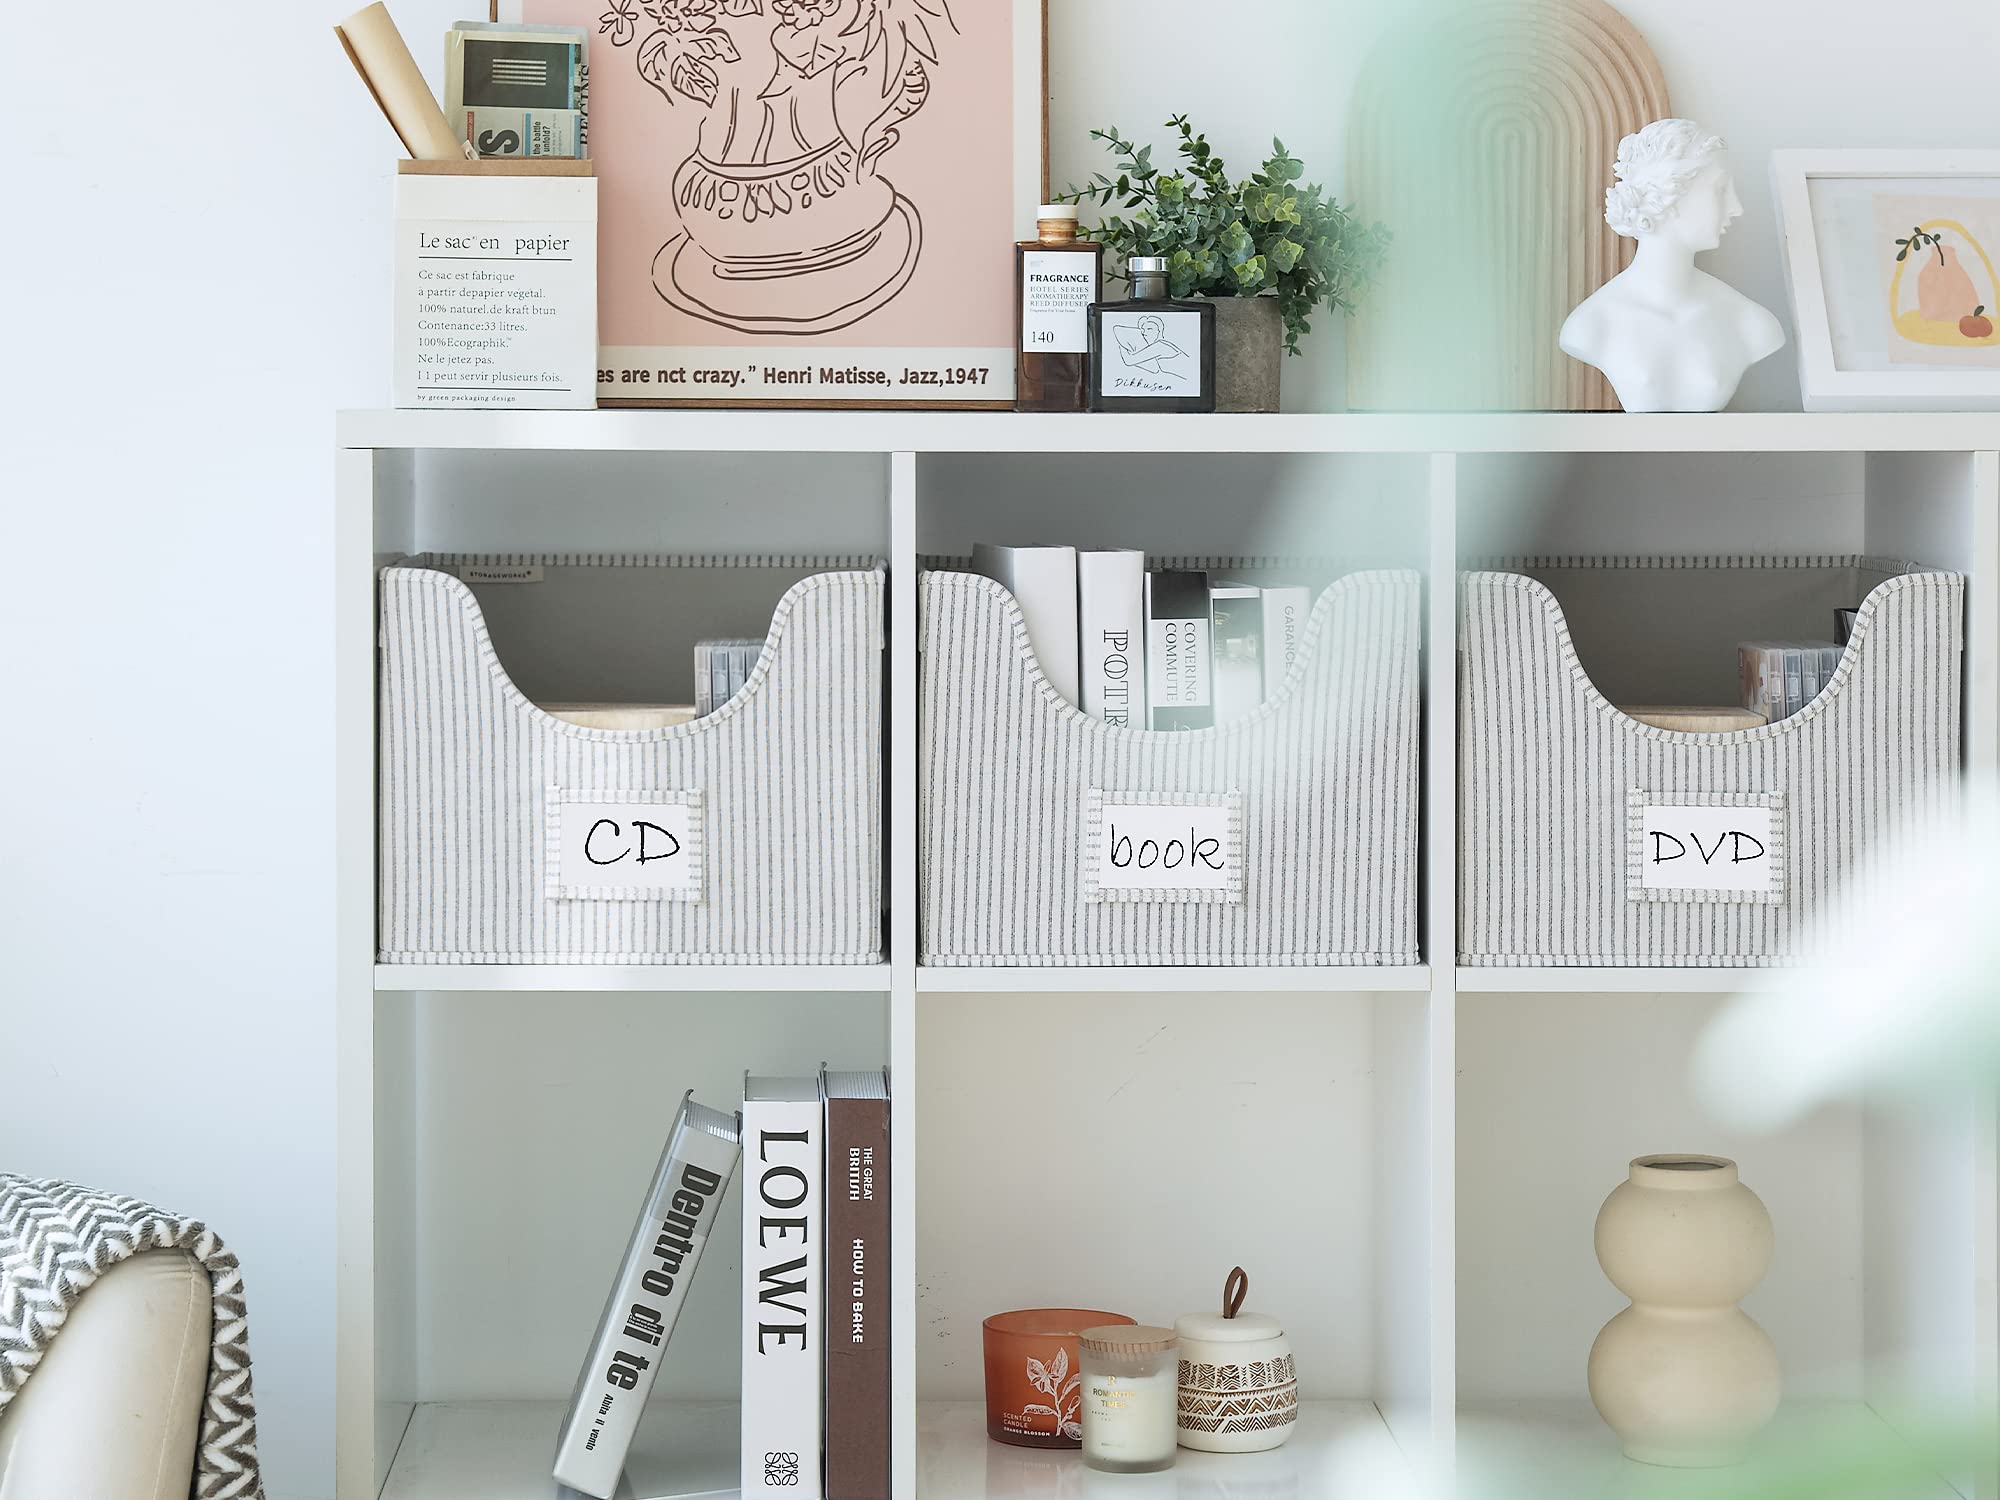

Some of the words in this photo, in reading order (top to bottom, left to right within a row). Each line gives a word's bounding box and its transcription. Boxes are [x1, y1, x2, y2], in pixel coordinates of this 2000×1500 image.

[478, 129, 520, 156] S
[533, 121, 541, 141] battle
[542, 125, 551, 153] unfold?
[533, 142, 541, 155] the
[420, 232, 440, 249] Le
[479, 237, 500, 250] en
[515, 234, 570, 255] papier
[418, 270, 433, 280] Ce
[455, 272, 469, 280] est
[472, 270, 515, 283] fabrique
[1030, 274, 1089, 283] FRAGRANCE
[427, 288, 457, 299] partir
[459, 287, 505, 299] depapier
[419, 303, 447, 314] 100%
[505, 305, 529, 315] kraft
[418, 320, 496, 331] Contenance:33
[499, 321, 528, 331] litres.
[1032, 330, 1054, 344] 140
[418, 354, 433, 364] Ne
[436, 354, 445, 364] le
[447, 354, 472, 366] jetez
[475, 356, 495, 366] pas.
[434, 373, 457, 383] peut
[460, 371, 489, 381] servir
[492, 372, 539, 383] plusieurs
[541, 372, 562, 382] fois.
[597, 369, 614, 383] es
[621, 369, 650, 383] are
[763, 366, 812, 385] Henri
[819, 366, 892, 387] Matisse,
[899, 367, 989, 387] Jazz,1947
[451, 394, 489, 402] packaging
[1165, 622, 1178, 702] COMMUTE
[1184, 622, 1197, 702] COVERING
[585, 819, 680, 865] CD
[1111, 823, 1225, 870] book
[1649, 831, 1765, 865] DVD
[864, 1146, 872, 1165] THE
[849, 1147, 860, 1201] BRITISH
[864, 1167, 872, 1201] GREAT
[641, 1163, 722, 1297] Dentro
[758, 1129, 809, 1356] LOEWE
[852, 1238, 864, 1275] HOW
[852, 1279, 864, 1297] TO
[622, 1303, 665, 1347] di
[852, 1301, 864, 1343] BAKE
[606, 1350, 651, 1391] te
[598, 1393, 614, 1416] Abita
[1003, 1412, 1032, 1422] SCENTED
[1003, 1419, 1028, 1428] CANDLE
[585, 1427, 602, 1451] vento
